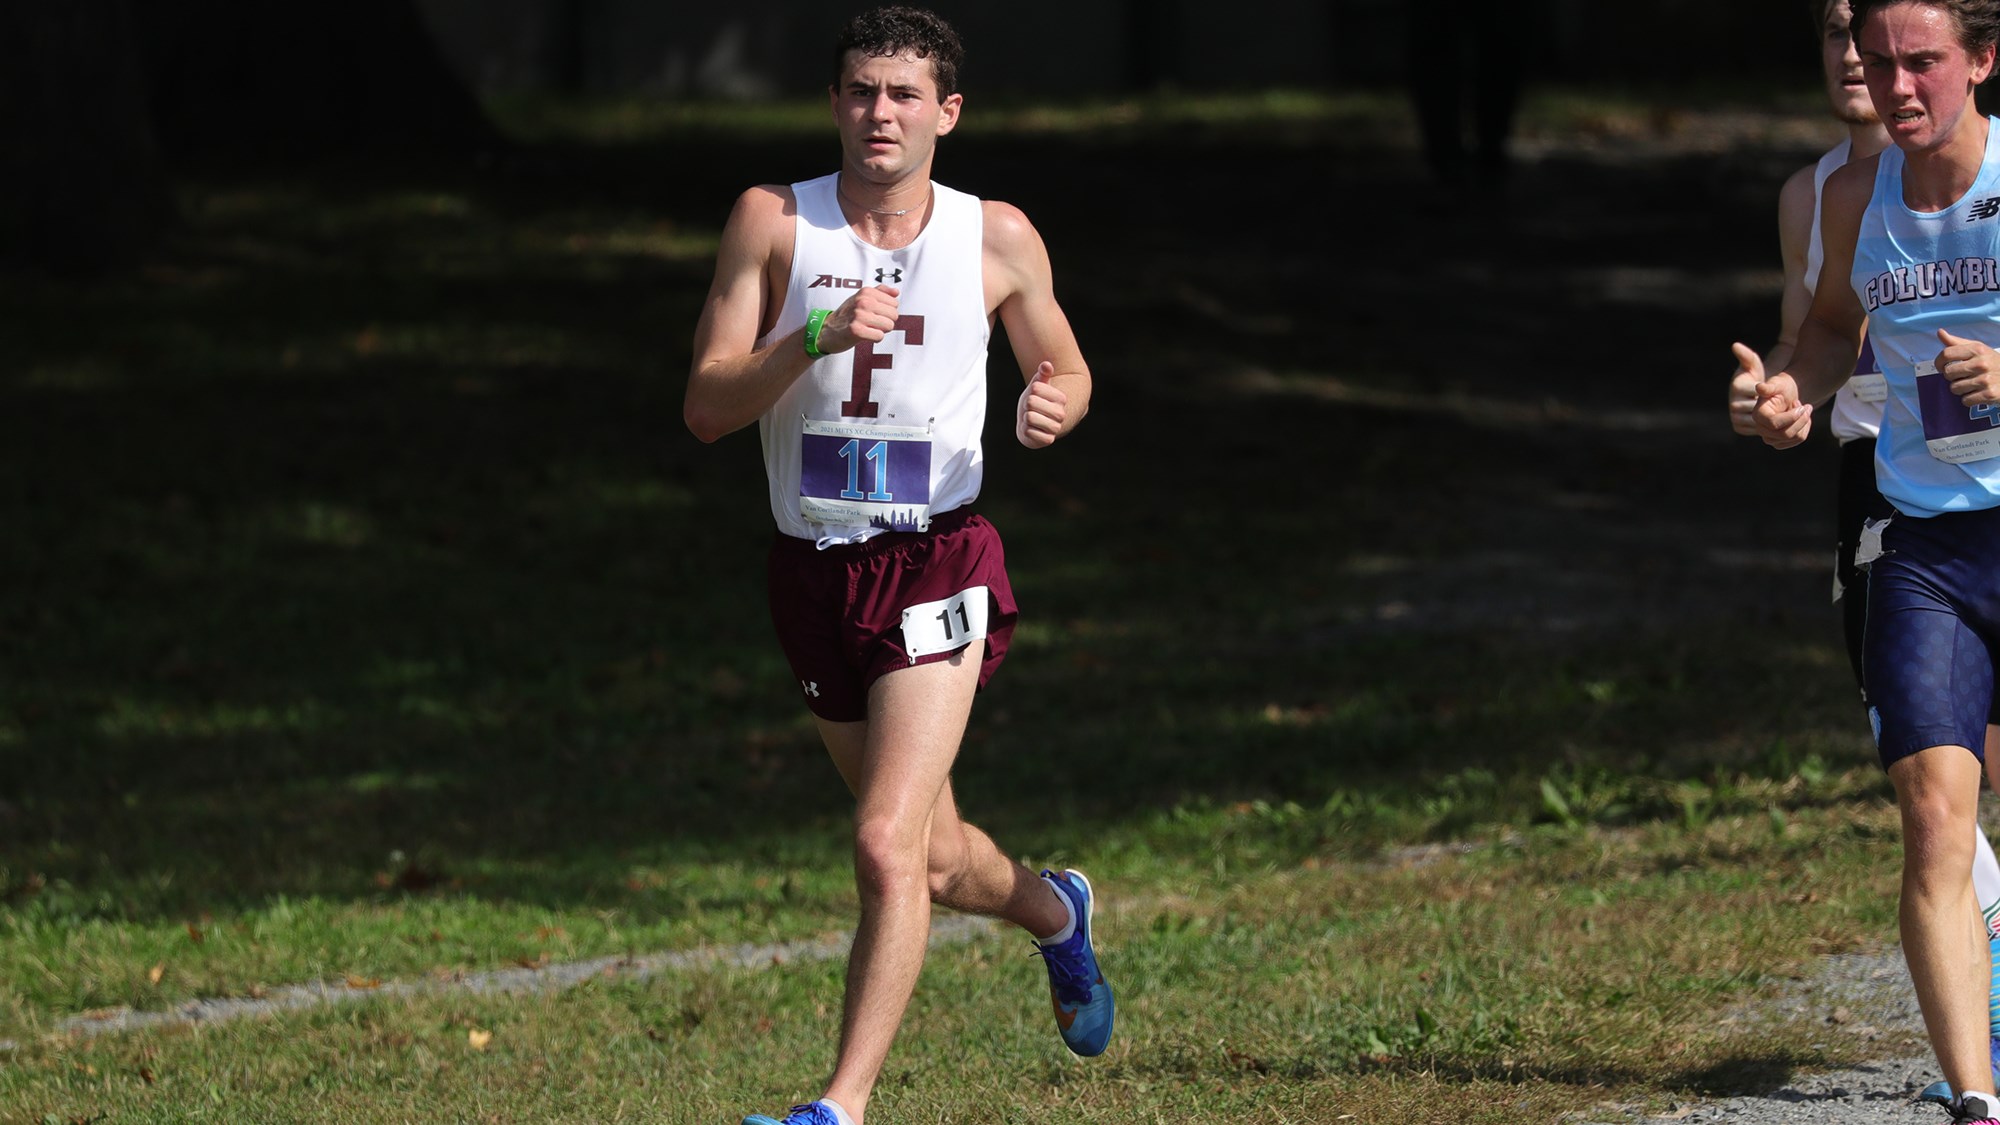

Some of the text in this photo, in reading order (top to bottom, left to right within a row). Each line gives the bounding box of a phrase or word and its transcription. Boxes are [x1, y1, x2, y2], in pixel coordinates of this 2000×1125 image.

[1864, 257, 2000, 312] COLUMBI
[1975, 439, 1990, 447] Park
[838, 439, 893, 501] 11
[936, 601, 970, 640] 11
